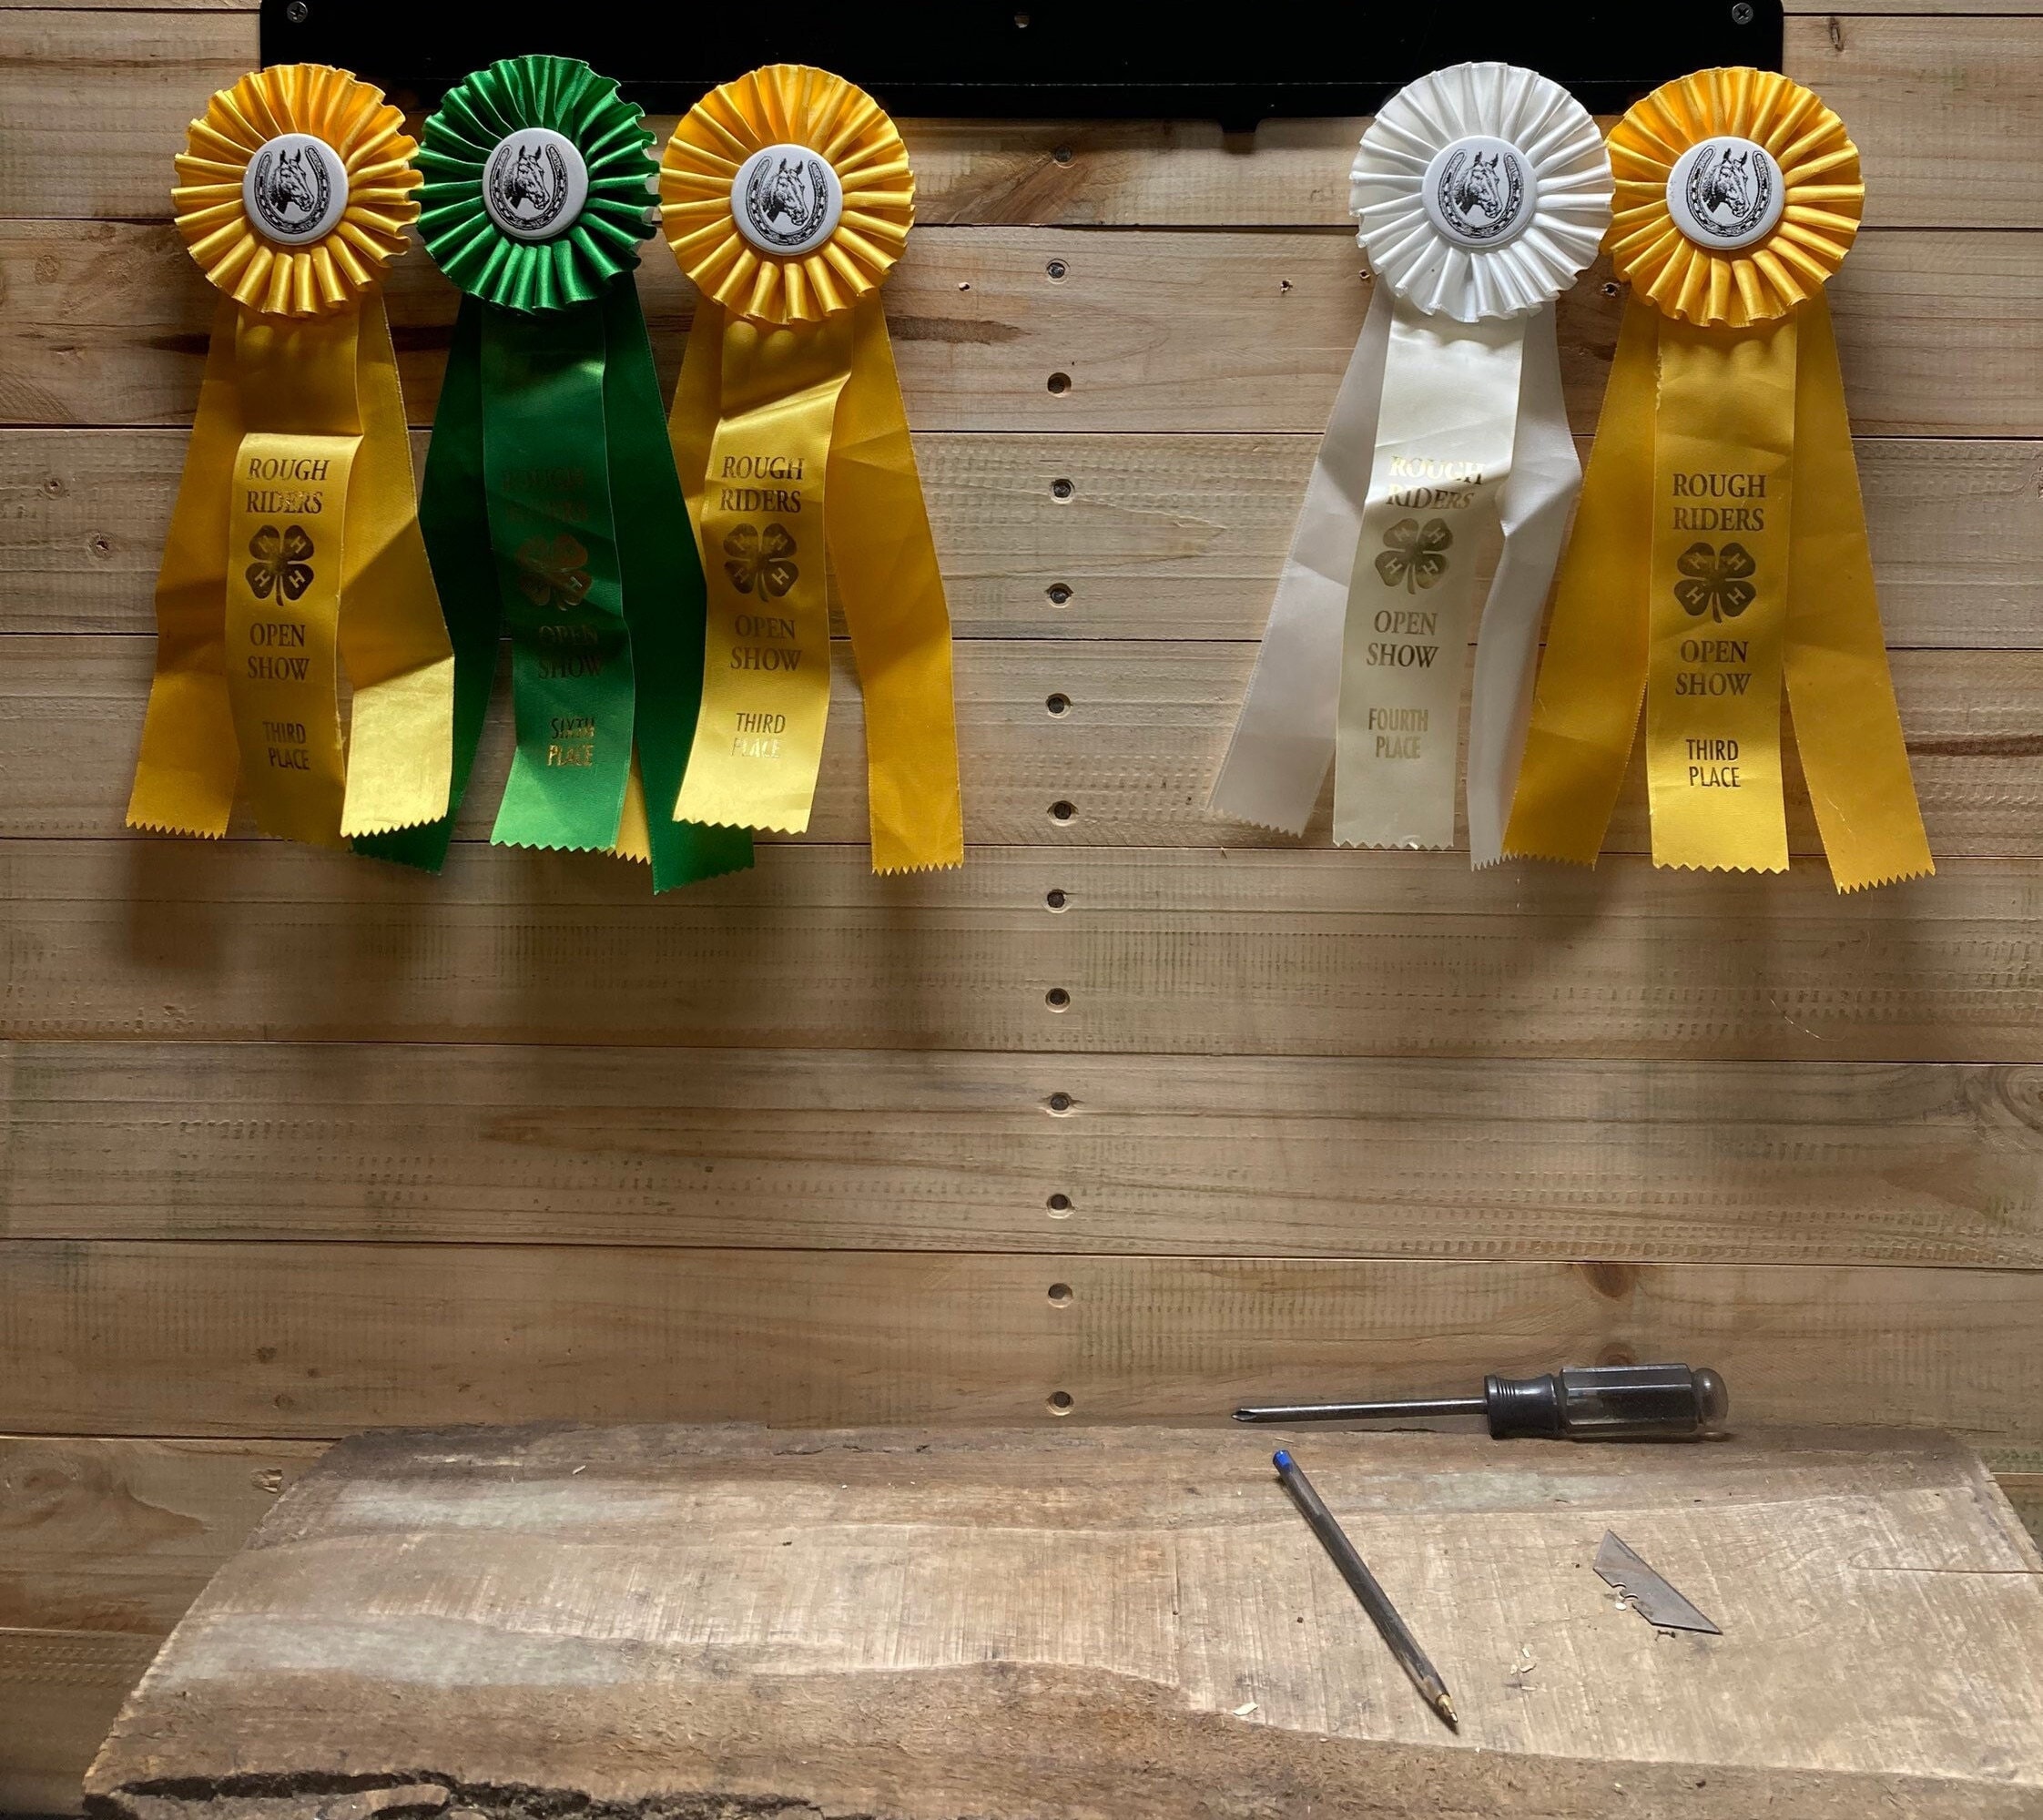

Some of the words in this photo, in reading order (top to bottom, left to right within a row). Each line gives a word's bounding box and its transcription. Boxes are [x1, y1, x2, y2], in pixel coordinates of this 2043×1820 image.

[246, 458, 330, 482] ROUGH
[721, 456, 804, 480] ROUGH
[1389, 455, 1486, 484] ROUGH
[1386, 483, 1475, 510] RIDERS
[1672, 473, 1767, 498] ROUGH
[246, 491, 323, 514] RIDERS
[719, 488, 801, 513] RIDERS
[1673, 507, 1764, 532] RIDERS
[290, 536, 307, 554] H
[255, 570, 270, 588] H
[290, 571, 306, 588] H
[771, 567, 789, 585] H
[735, 614, 796, 640] OPEN
[1374, 610, 1438, 636] OPEN
[249, 623, 306, 647] OPEN
[730, 647, 801, 671] SHOW
[1367, 643, 1439, 668] SHOW
[1680, 640, 1748, 663] OPEN
[248, 656, 310, 681] SHOW
[539, 655, 602, 678] SHOW
[1675, 673, 1752, 696] SHOW
[551, 717, 595, 739] SIXTH
[736, 713, 786, 734] THIRD
[1368, 707, 1428, 732] FOURTH
[263, 721, 307, 744] THIRD
[269, 747, 310, 770] PLACE
[547, 745, 594, 767] PLACE
[730, 737, 780, 758] PLACE
[1376, 736, 1421, 758] PLACE
[1686, 738, 1739, 760] THIRD
[1689, 766, 1741, 787] PLACE
